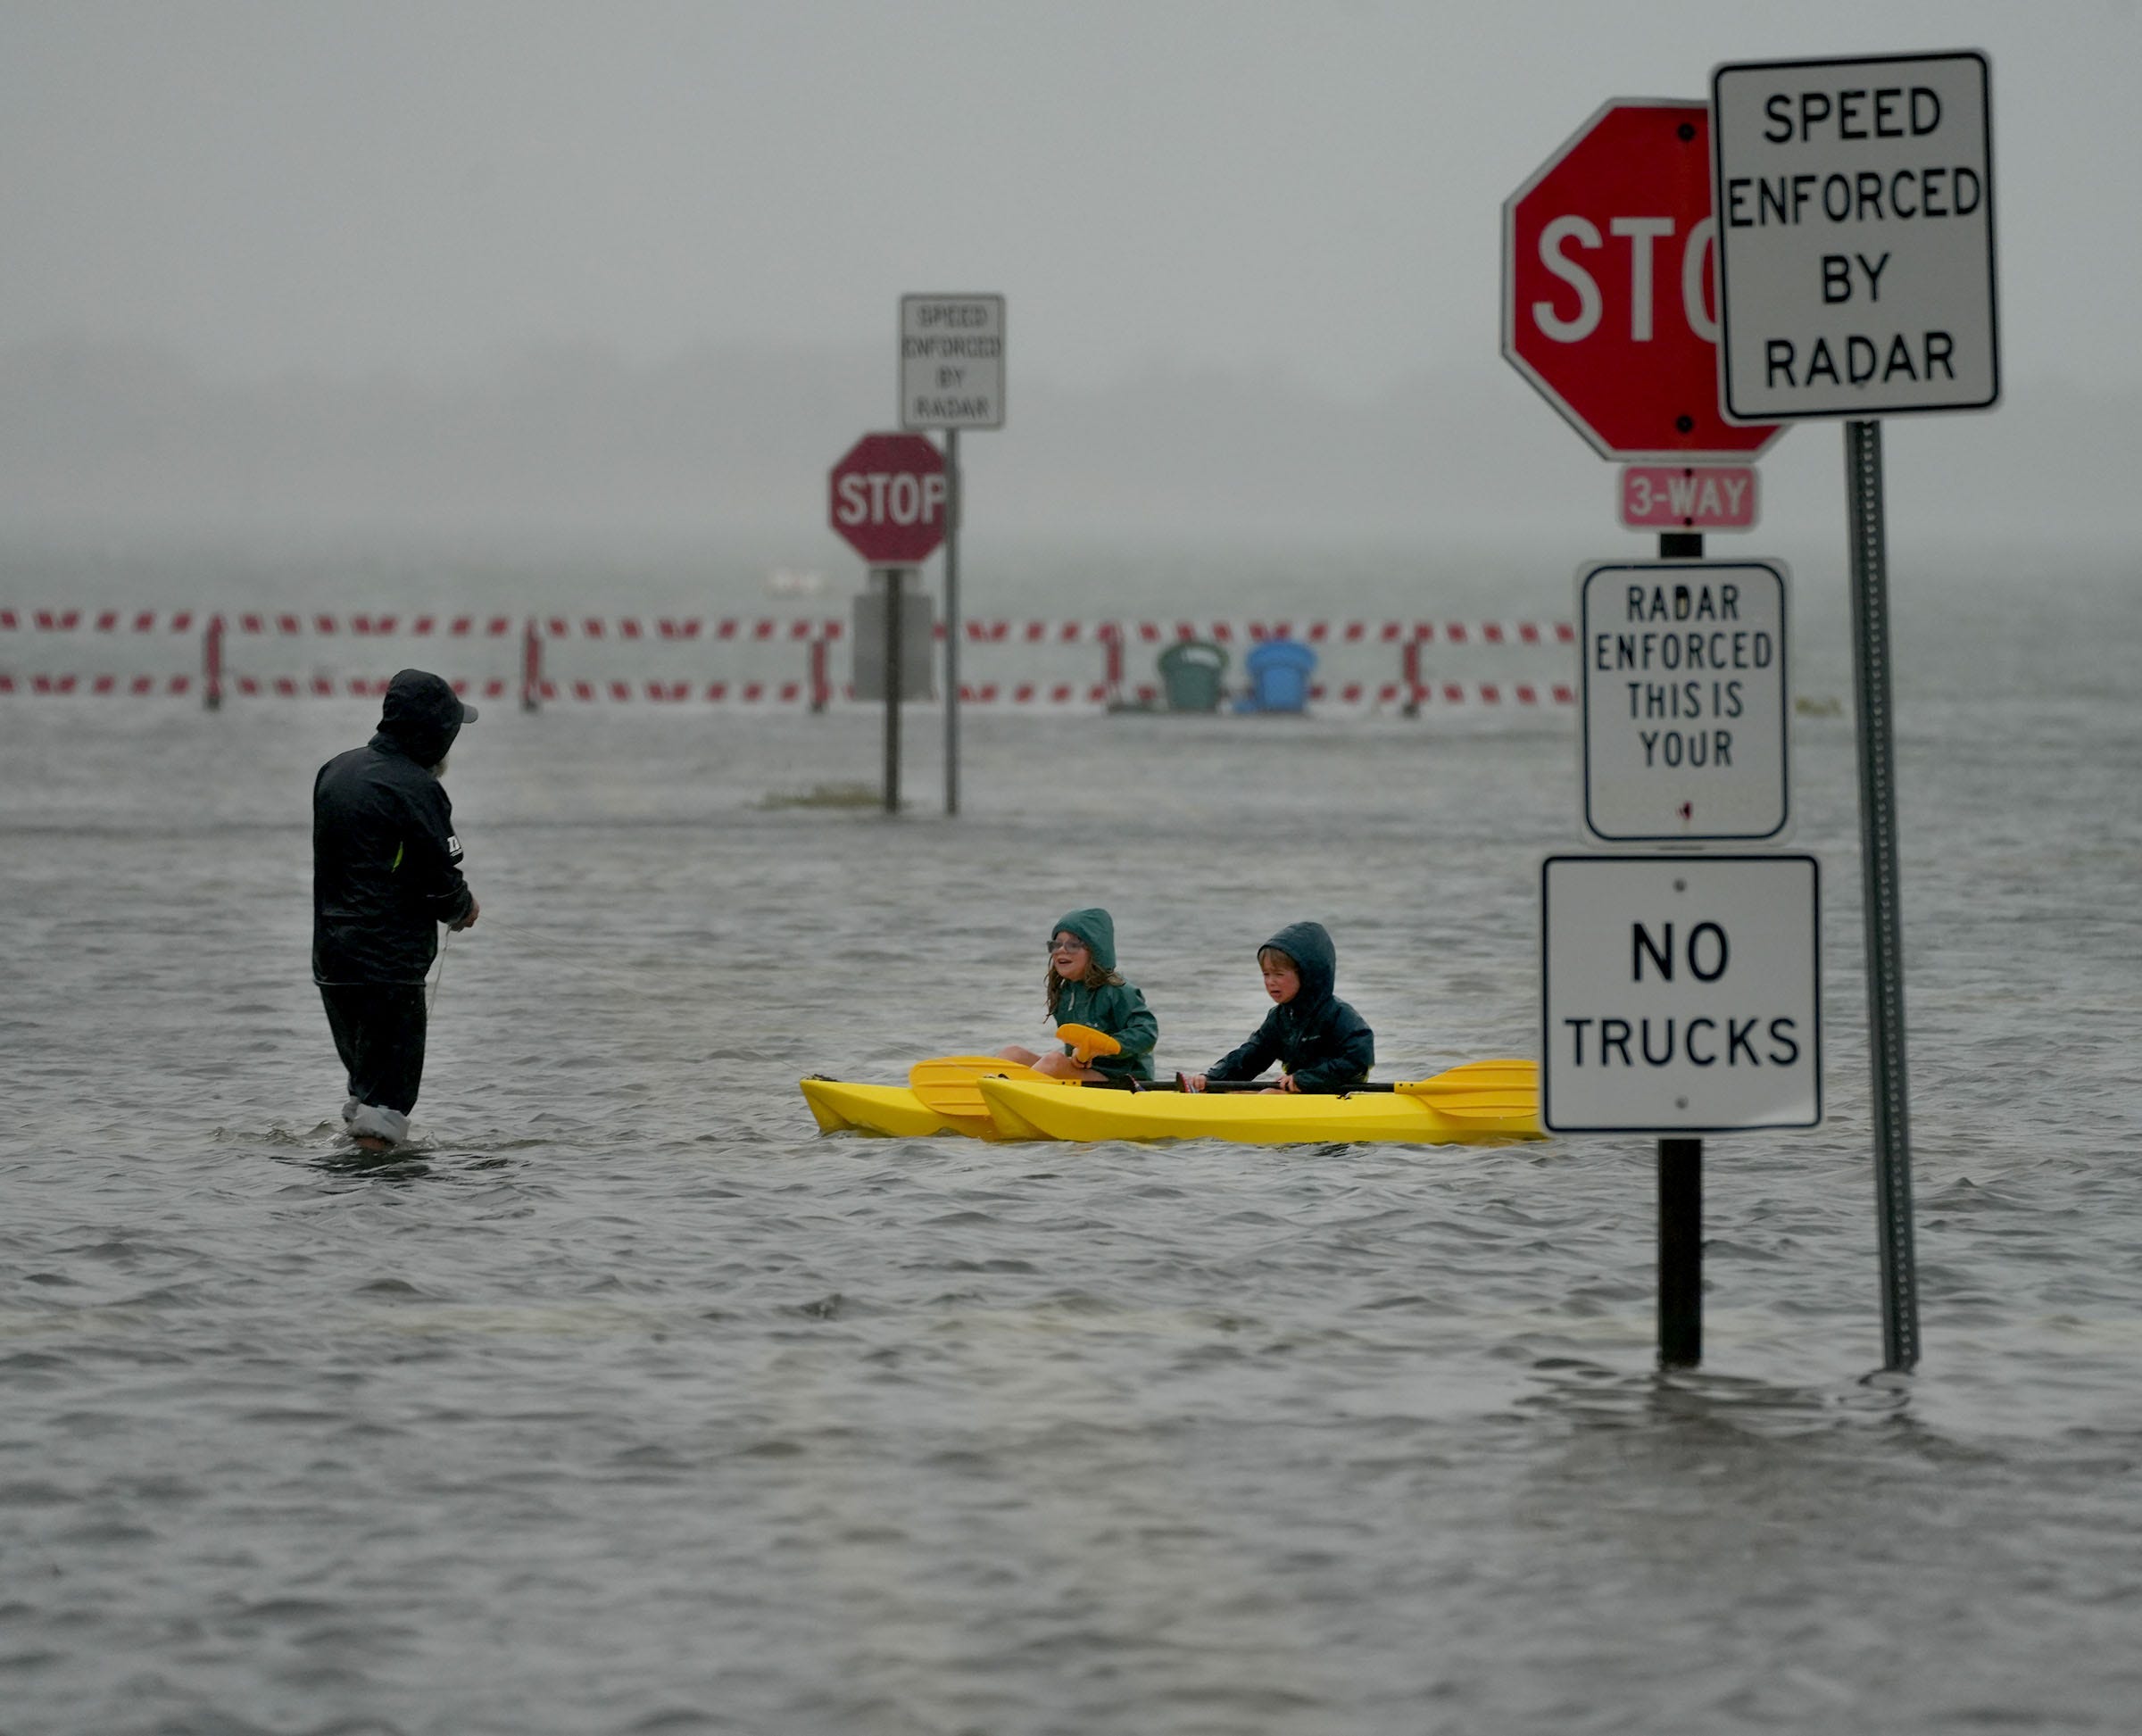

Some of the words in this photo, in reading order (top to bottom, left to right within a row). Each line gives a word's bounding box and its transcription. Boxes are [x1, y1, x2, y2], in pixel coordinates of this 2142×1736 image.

[1764, 87, 1942, 143] SPEED
[1729, 167, 1980, 227] ENFORCED
[1532, 215, 1717, 343] ST
[1822, 252, 1890, 303] BY
[917, 304, 988, 328] SPEED
[937, 366, 965, 388] BY
[1766, 331, 1955, 387] RADAR
[837, 472, 946, 525] STOP
[1629, 478, 1748, 517] 3-WAY
[1627, 585, 1739, 623] RADAR
[1596, 631, 1773, 671] ENFORCED
[1627, 682, 1699, 719] THIS
[1714, 681, 1744, 718] IS
[1640, 729, 1733, 768] YOUR
[1632, 922, 1730, 982] NO
[1564, 1018, 1799, 1067] TRUCKS
